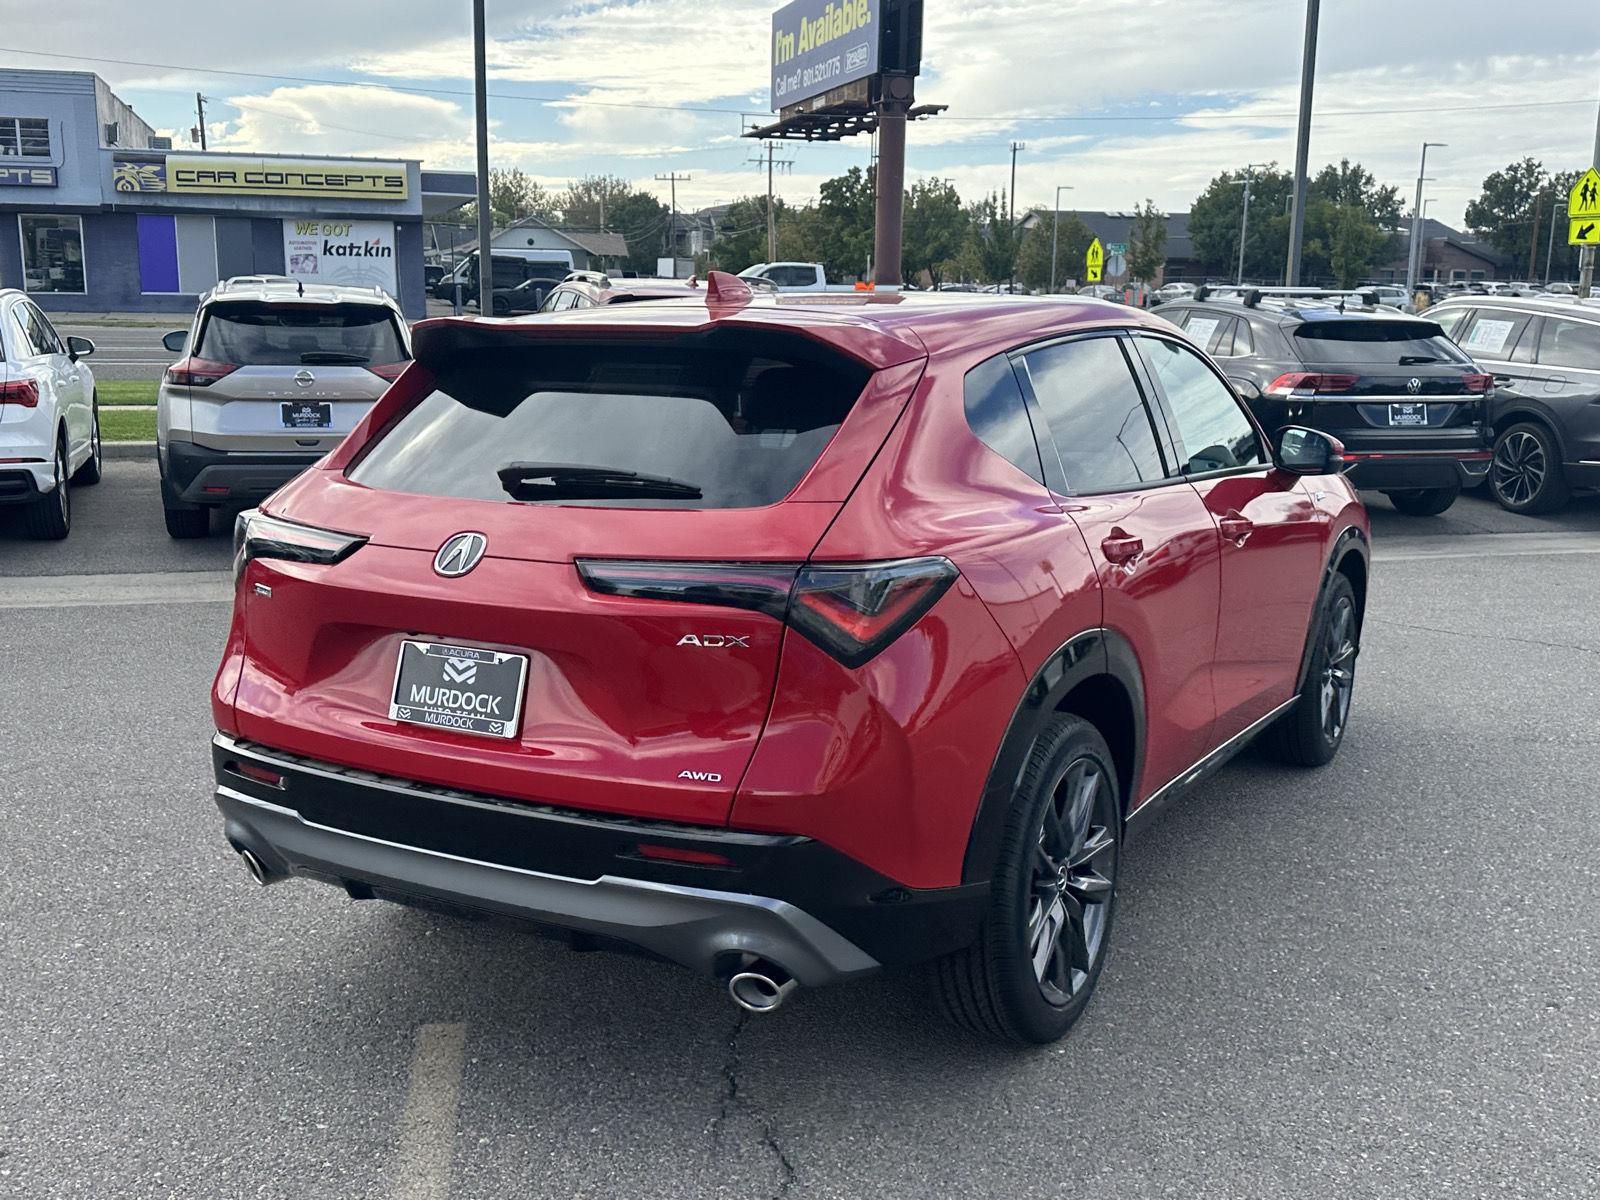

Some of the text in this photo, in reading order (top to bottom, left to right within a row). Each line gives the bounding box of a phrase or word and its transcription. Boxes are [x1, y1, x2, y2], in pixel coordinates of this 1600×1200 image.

[775, 0, 871, 66] I'm Available.
[775, 75, 786, 96] Call
[787, 68, 801, 92] me?
[175, 170, 404, 188] CAR CONCEPTS
[295, 222, 352, 237] WE GOT
[322, 238, 391, 257] katzkin
[676, 634, 750, 648] ADX
[448, 648, 480, 660] ACURA
[410, 684, 502, 715] MURDOCK
[424, 712, 474, 729] MURDOCK
[678, 770, 722, 782] AWD
